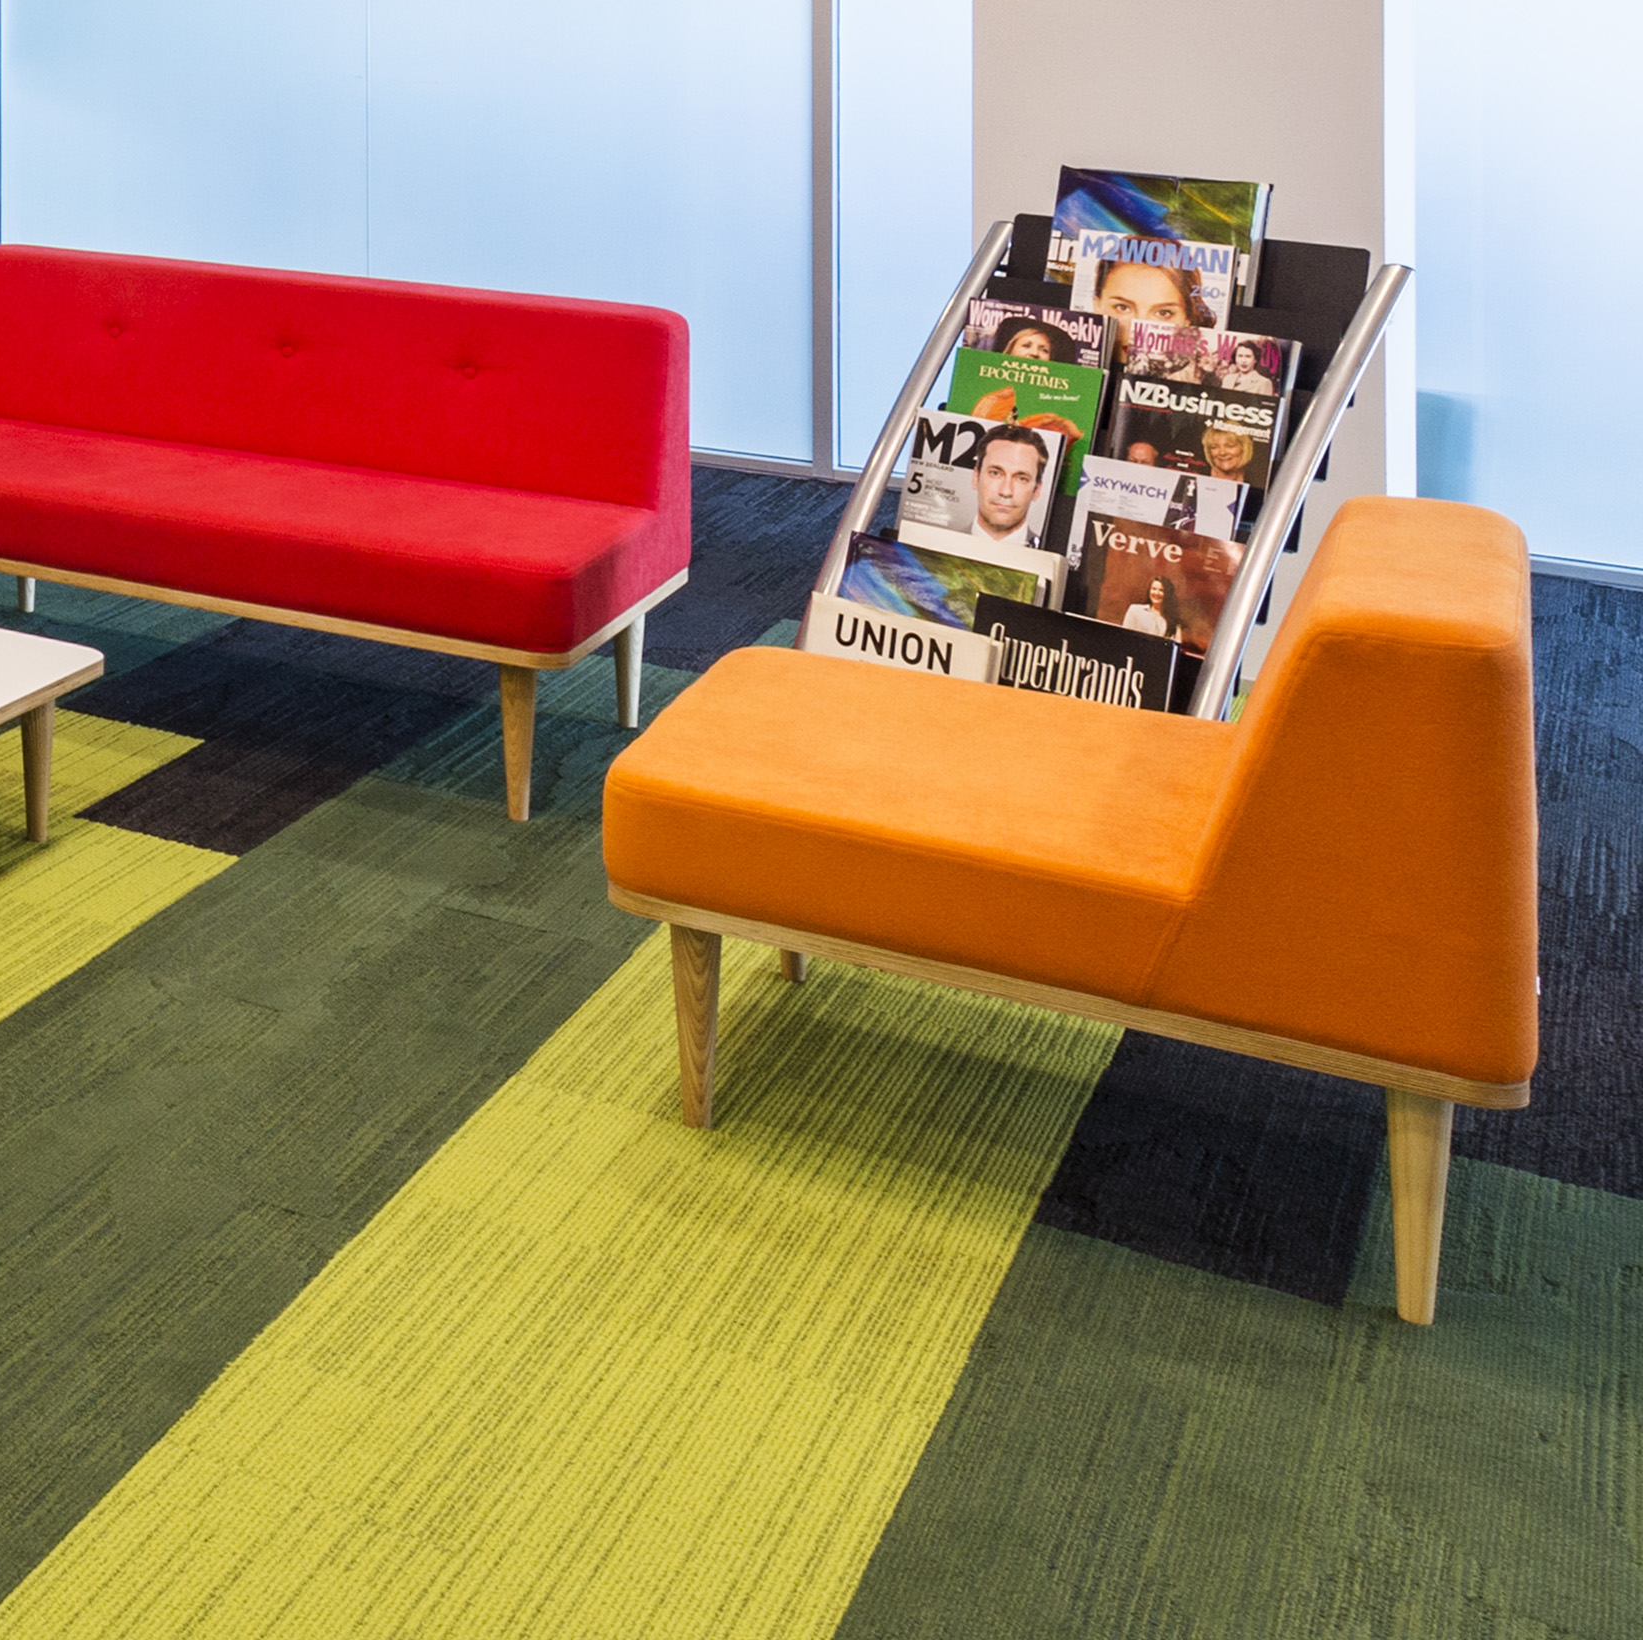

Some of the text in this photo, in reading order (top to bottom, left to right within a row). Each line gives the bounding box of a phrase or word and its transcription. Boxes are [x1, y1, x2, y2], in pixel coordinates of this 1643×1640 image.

[1081, 234, 1231, 275] M2WOMAN
[969, 300, 1037, 329] Wom'
[1217, 333, 1281, 374] Wly
[979, 364, 1026, 384] EPOCH
[1027, 372, 1070, 391] TIMES
[1118, 378, 1274, 427] NZBusiness
[911, 416, 988, 470] M2
[907, 471, 924, 495] 5
[1093, 475, 1168, 501] SKYWATCH
[1091, 519, 1184, 563] Verve
[834, 612, 954, 676] UNION
